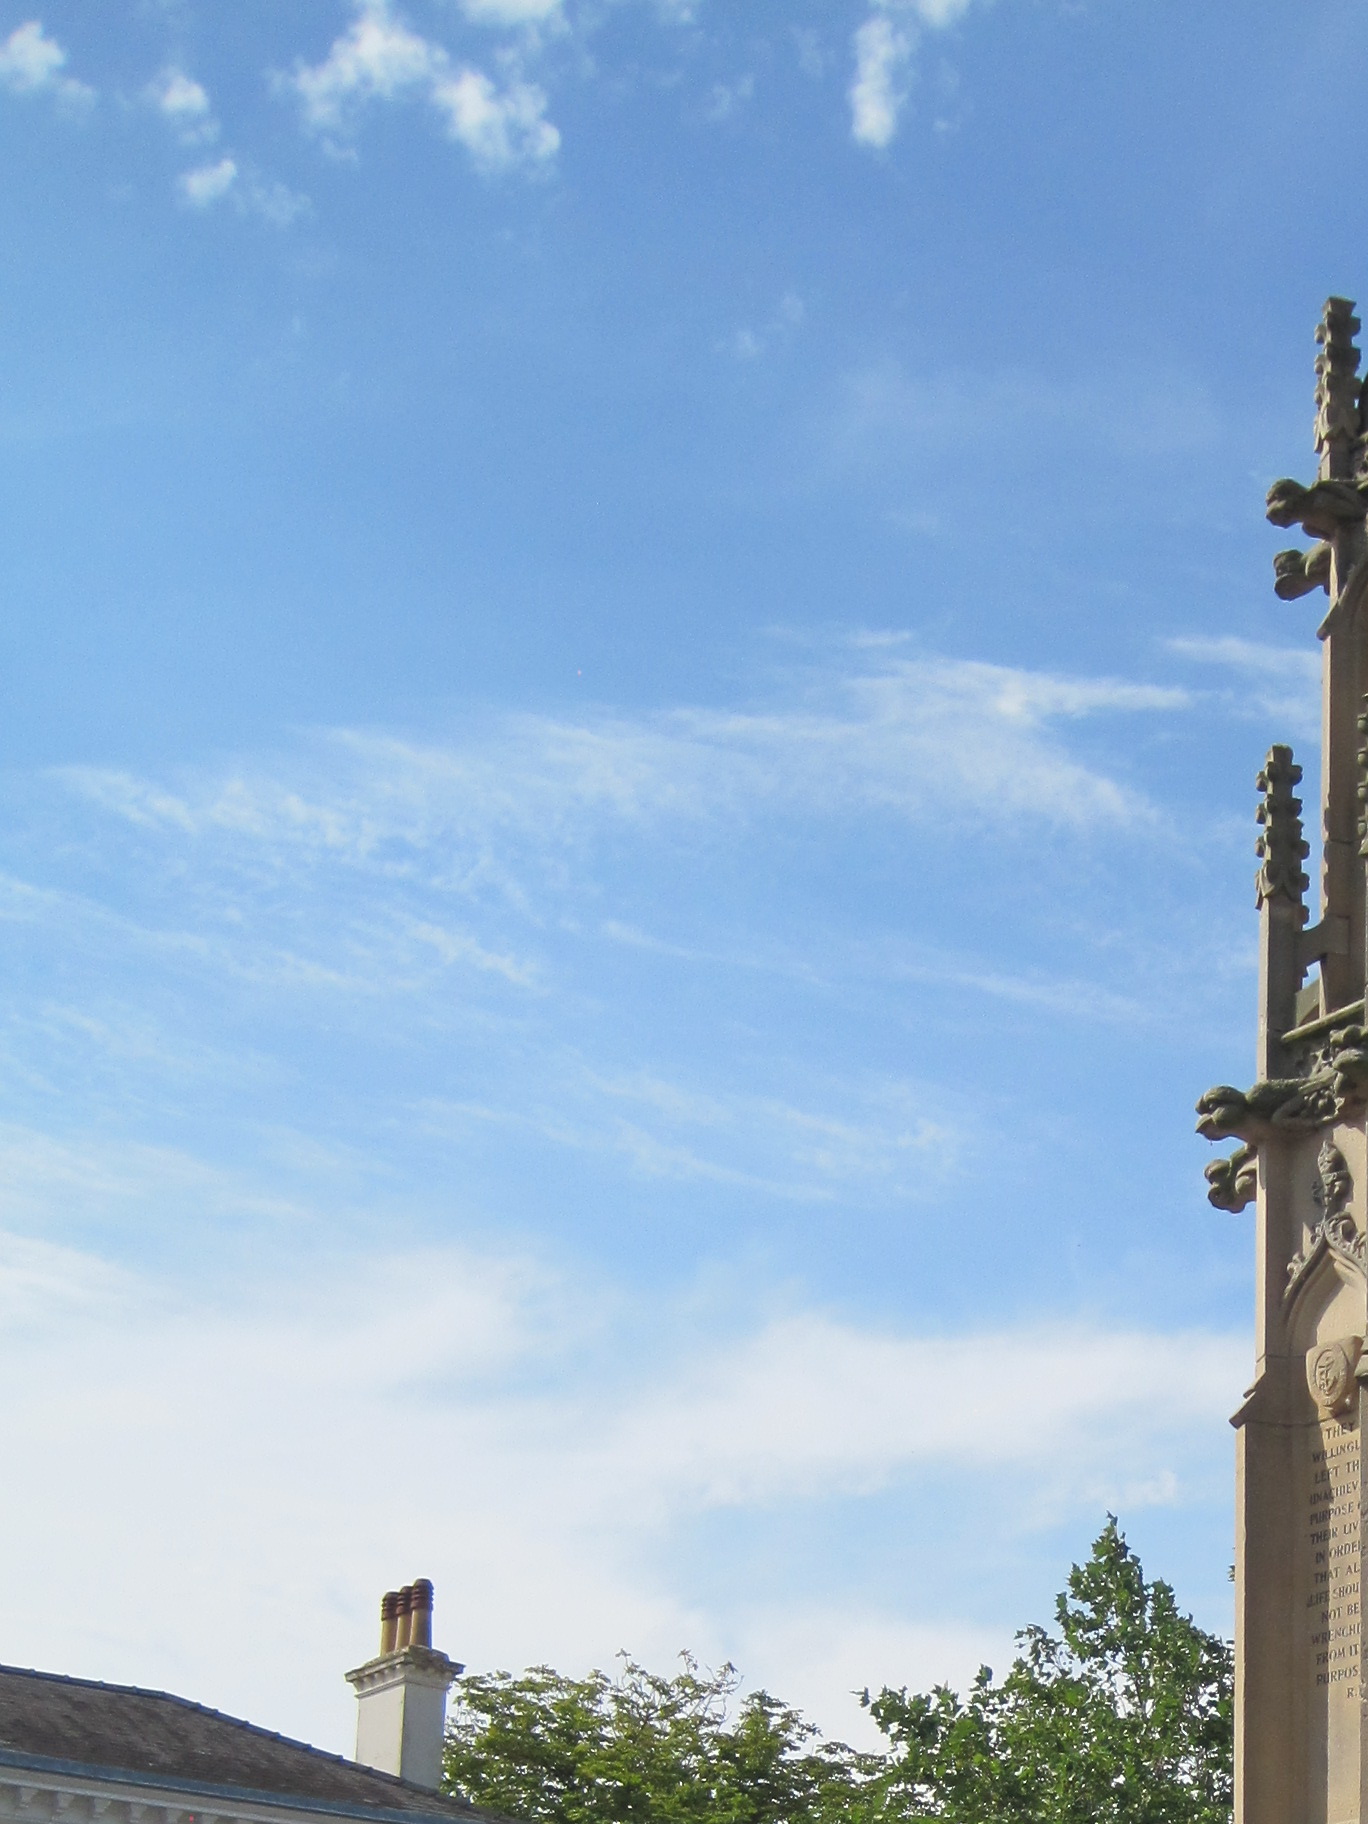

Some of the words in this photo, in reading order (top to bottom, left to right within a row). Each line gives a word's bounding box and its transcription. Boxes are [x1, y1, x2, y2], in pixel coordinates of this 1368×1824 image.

[1326, 1422, 1354, 1440] THEY
[1312, 1440, 1359, 1462] WILLINGL
[1315, 1468, 1340, 1484] LEFT
[1347, 1460, 1359, 1473] TH
[1310, 1502, 1354, 1525] PURPOSE
[1311, 1528, 1338, 1545] THEIR
[1343, 1521, 1359, 1535] LIV
[1315, 1549, 1325, 1560] IN
[1314, 1566, 1340, 1584] THAT
[1346, 1563, 1360, 1575] AL
[1321, 1606, 1342, 1624] NOT
[1347, 1603, 1359, 1614] BE
[1316, 1647, 1345, 1665] FROM
[1316, 1665, 1358, 1686] PURPOS
